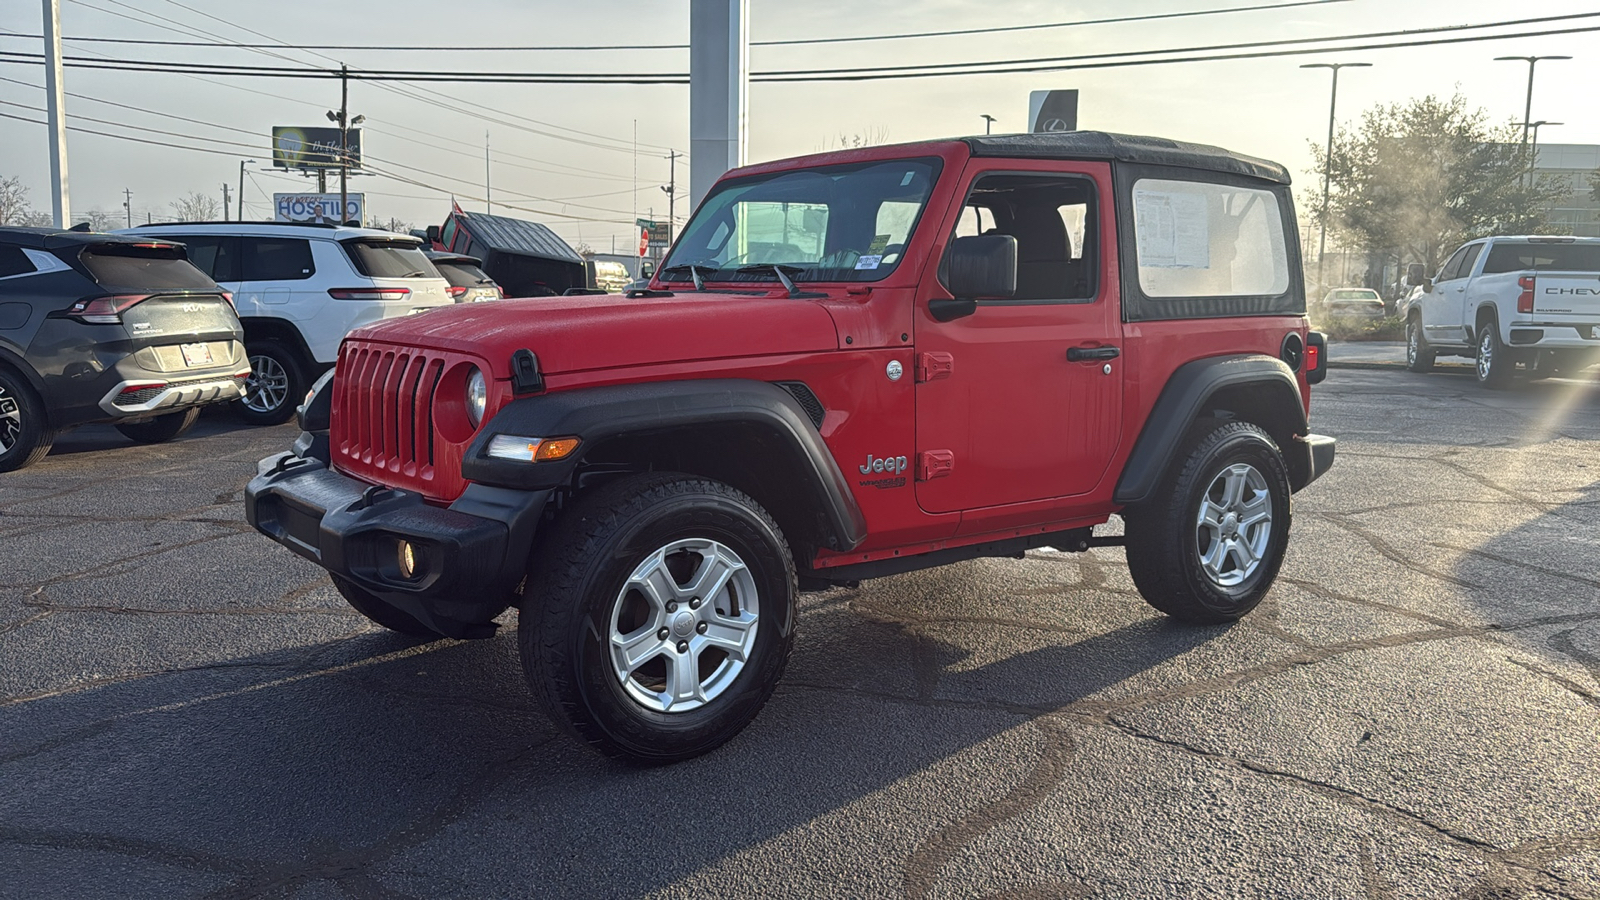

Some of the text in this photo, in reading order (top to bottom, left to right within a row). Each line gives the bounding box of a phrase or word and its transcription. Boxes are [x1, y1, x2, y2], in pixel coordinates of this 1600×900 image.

[279, 202, 359, 215] HOSTILO
[183, 303, 203, 312] KIA
[859, 454, 907, 475] Jeep
[859, 477, 907, 487] WRANGLER
